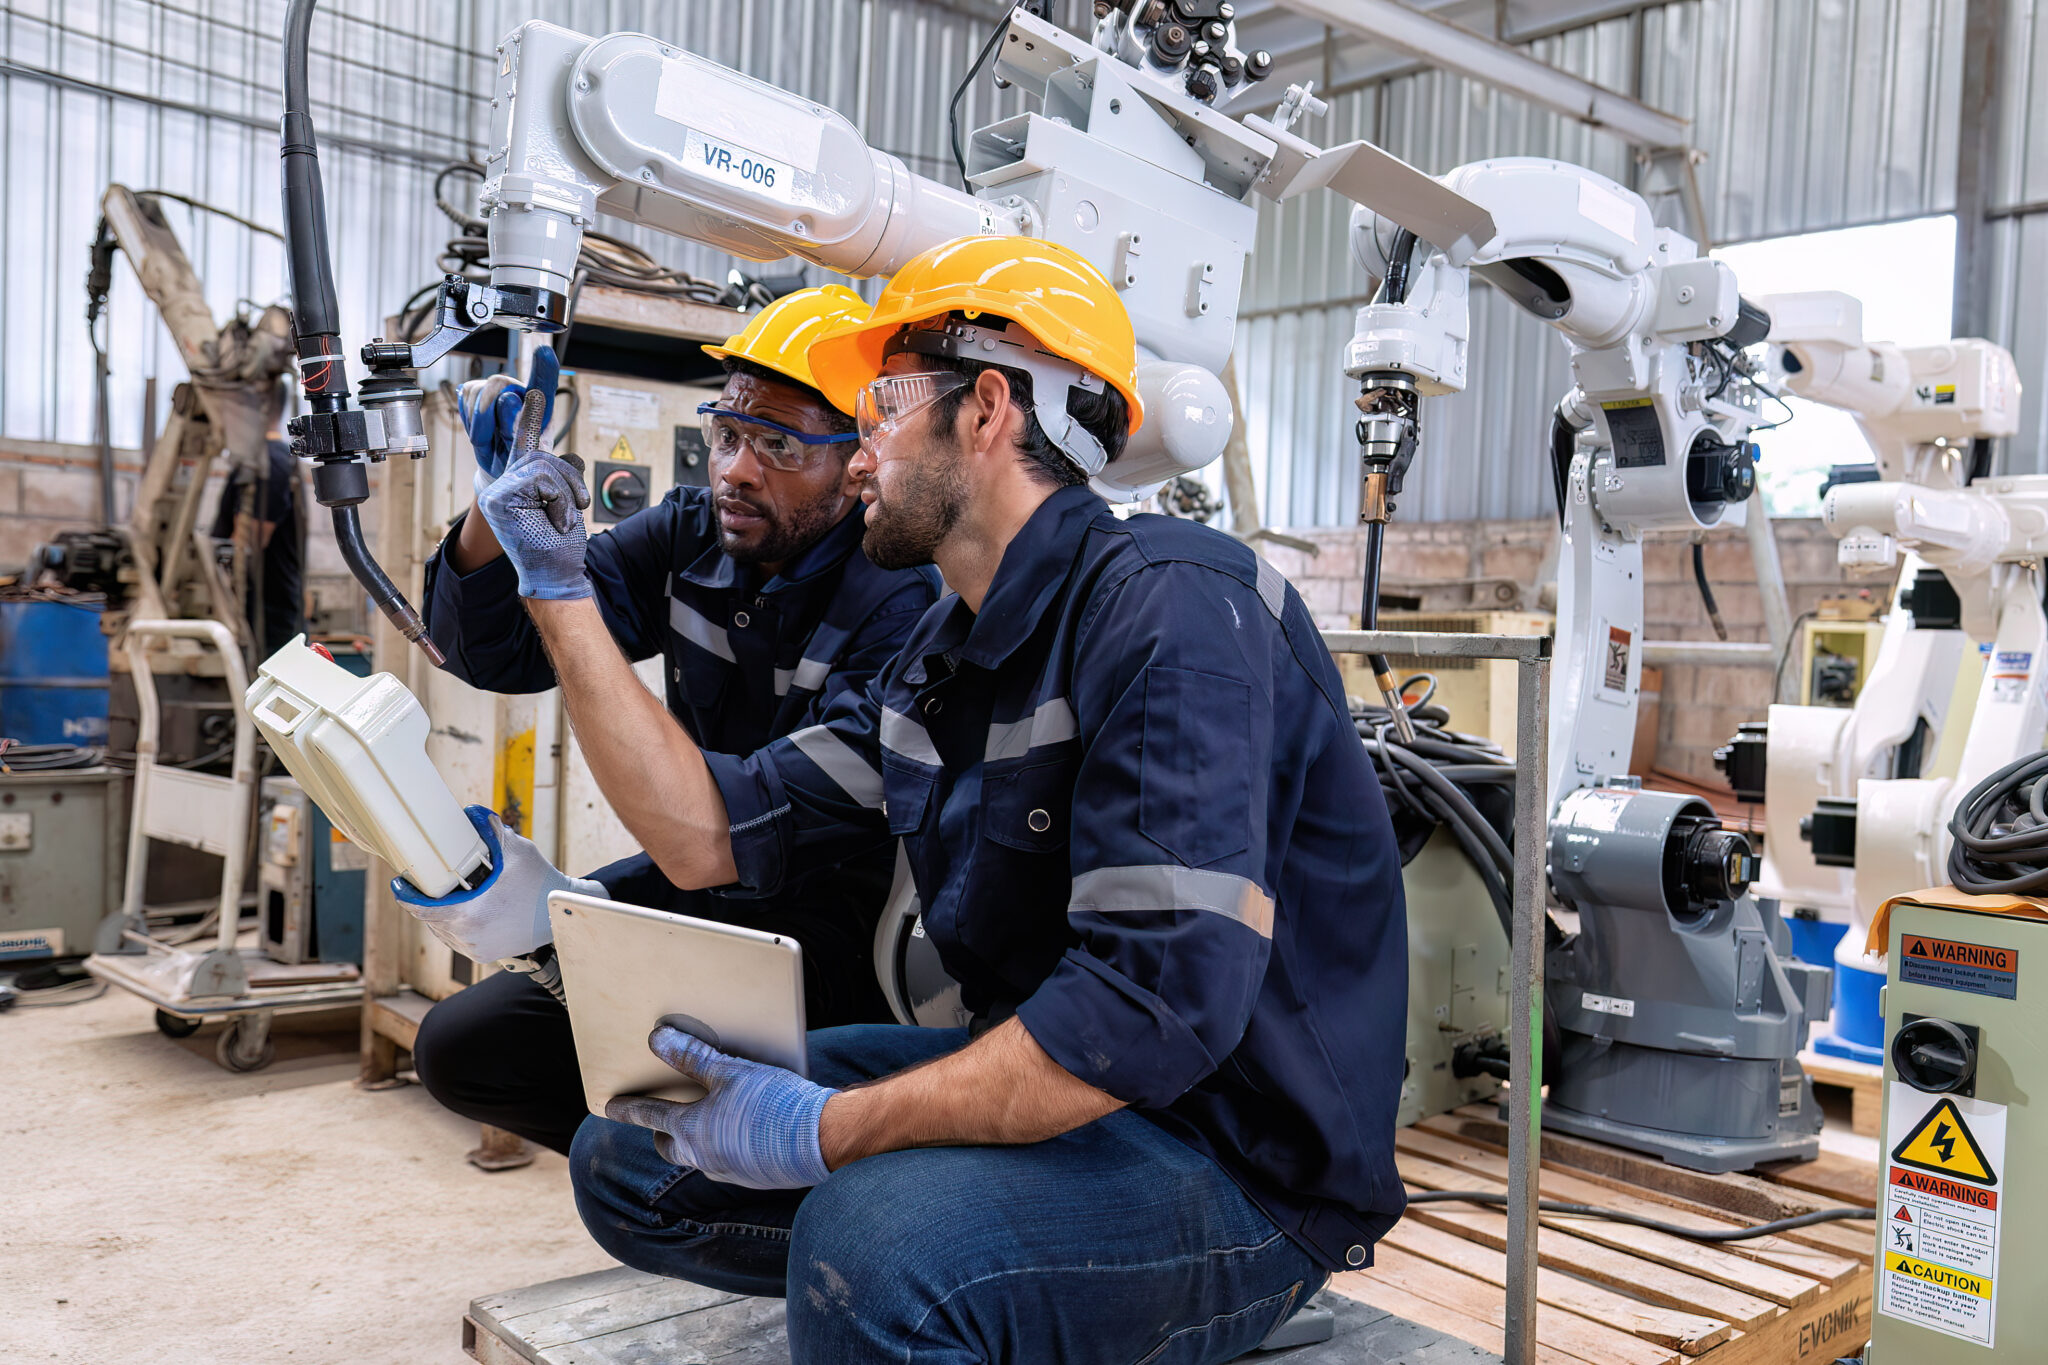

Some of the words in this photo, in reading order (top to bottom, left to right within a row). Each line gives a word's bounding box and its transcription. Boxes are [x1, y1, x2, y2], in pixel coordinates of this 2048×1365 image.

[704, 143, 775, 187] VR-006
[1932, 941, 2007, 968] WARNING
[1916, 1175, 1988, 1206] WARNING
[1892, 1273, 1921, 1287] Encoder
[1923, 1283, 1950, 1296] backup
[1952, 1292, 1979, 1305] battery
[1913, 1264, 1980, 1294] CAUTION
[1799, 1296, 1859, 1358] EVONIK
